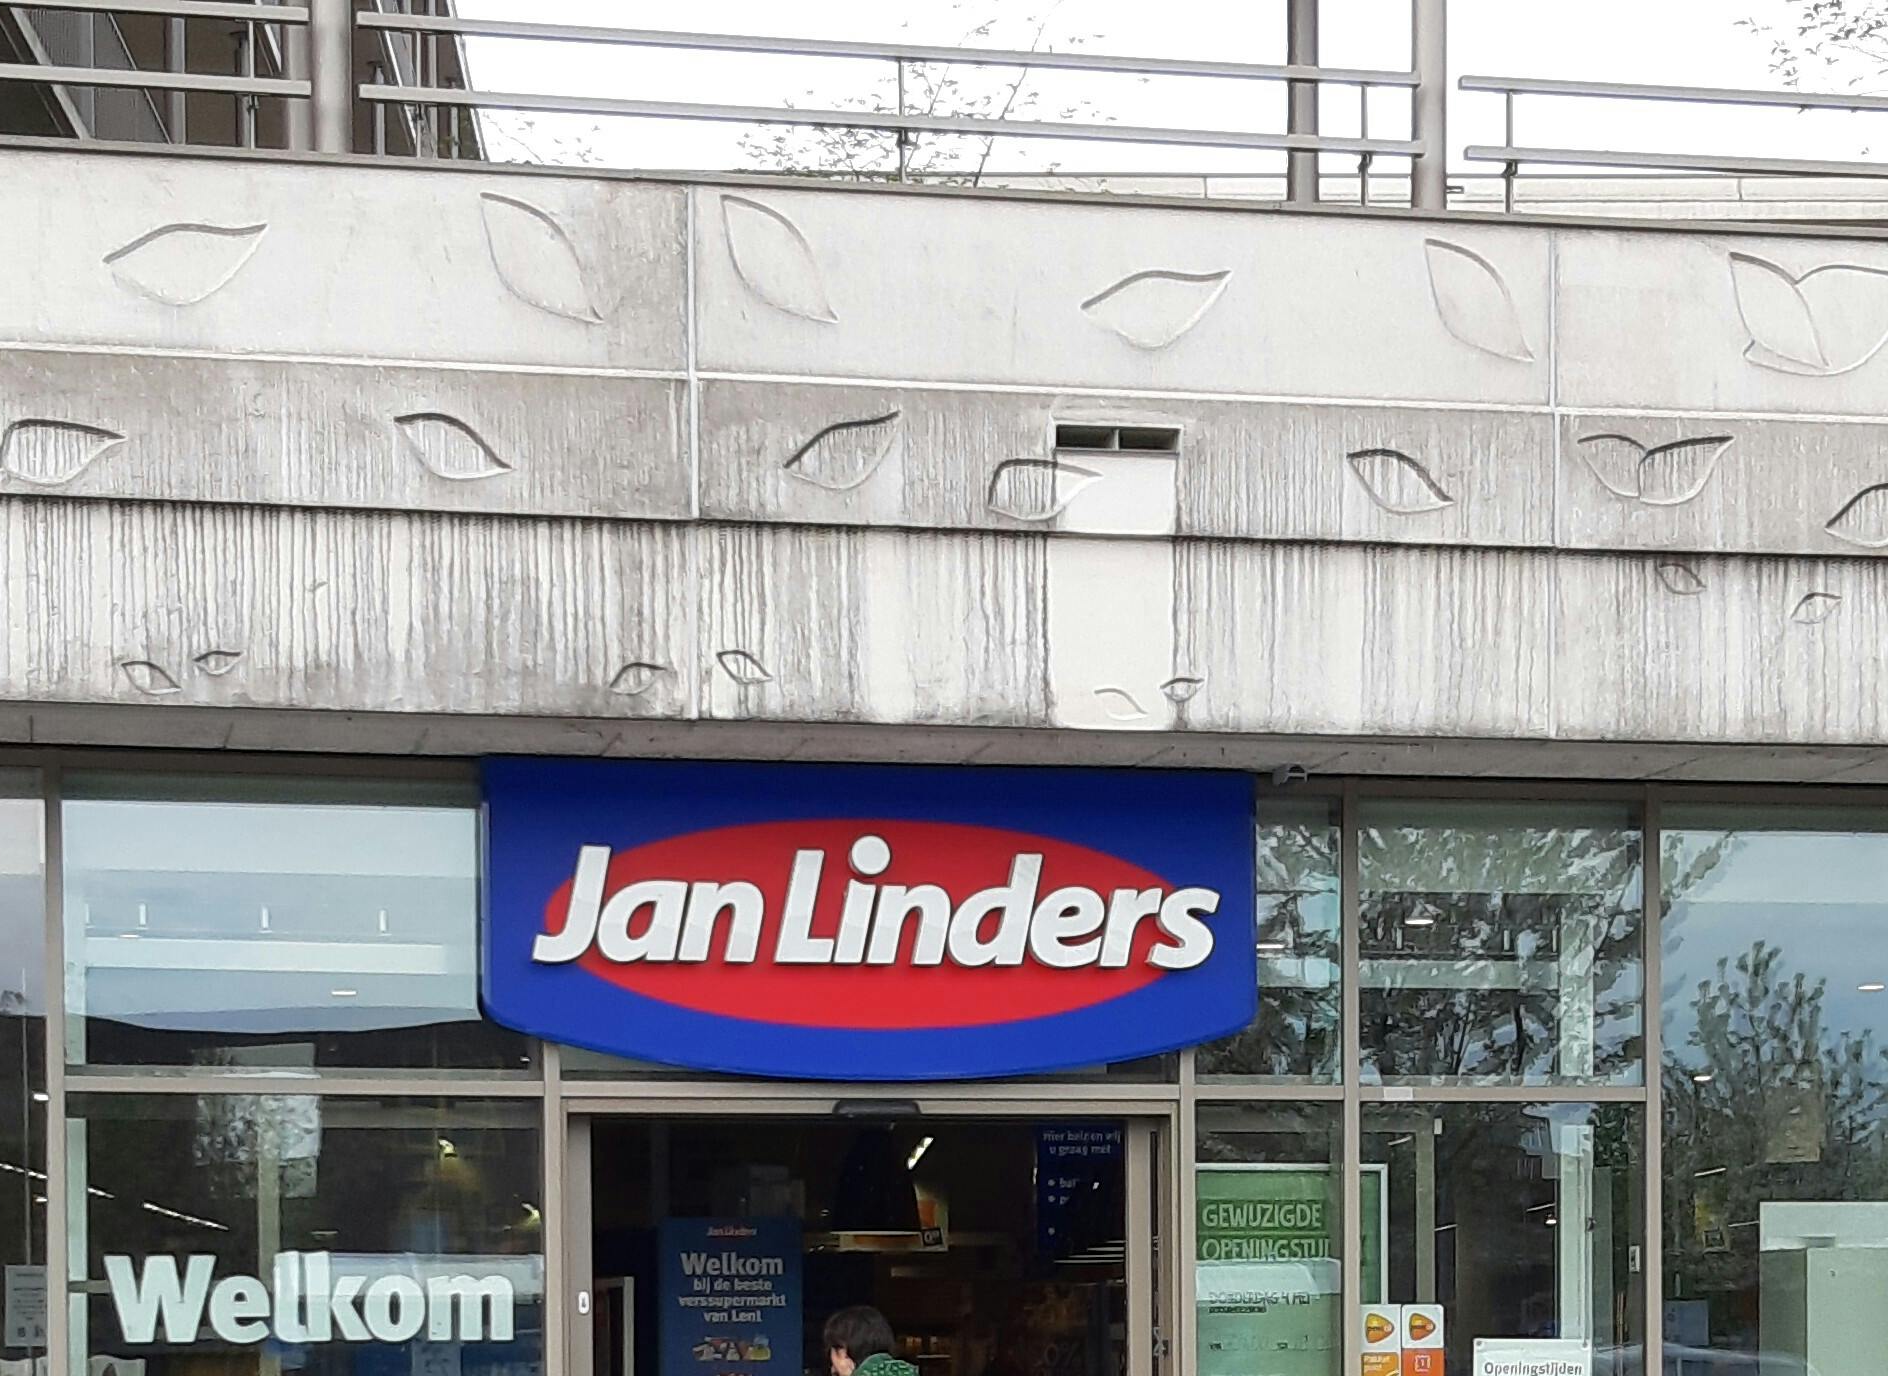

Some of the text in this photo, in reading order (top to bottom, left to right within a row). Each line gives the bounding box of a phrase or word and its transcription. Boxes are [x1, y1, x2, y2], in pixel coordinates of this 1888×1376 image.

[532, 834, 1220, 970] Jan Linders
[680, 1251, 784, 1276] Welkom
[714, 1277, 730, 1291] de
[104, 1252, 514, 1343] Welkom
[1484, 1362, 1582, 1376] Openingstijden
